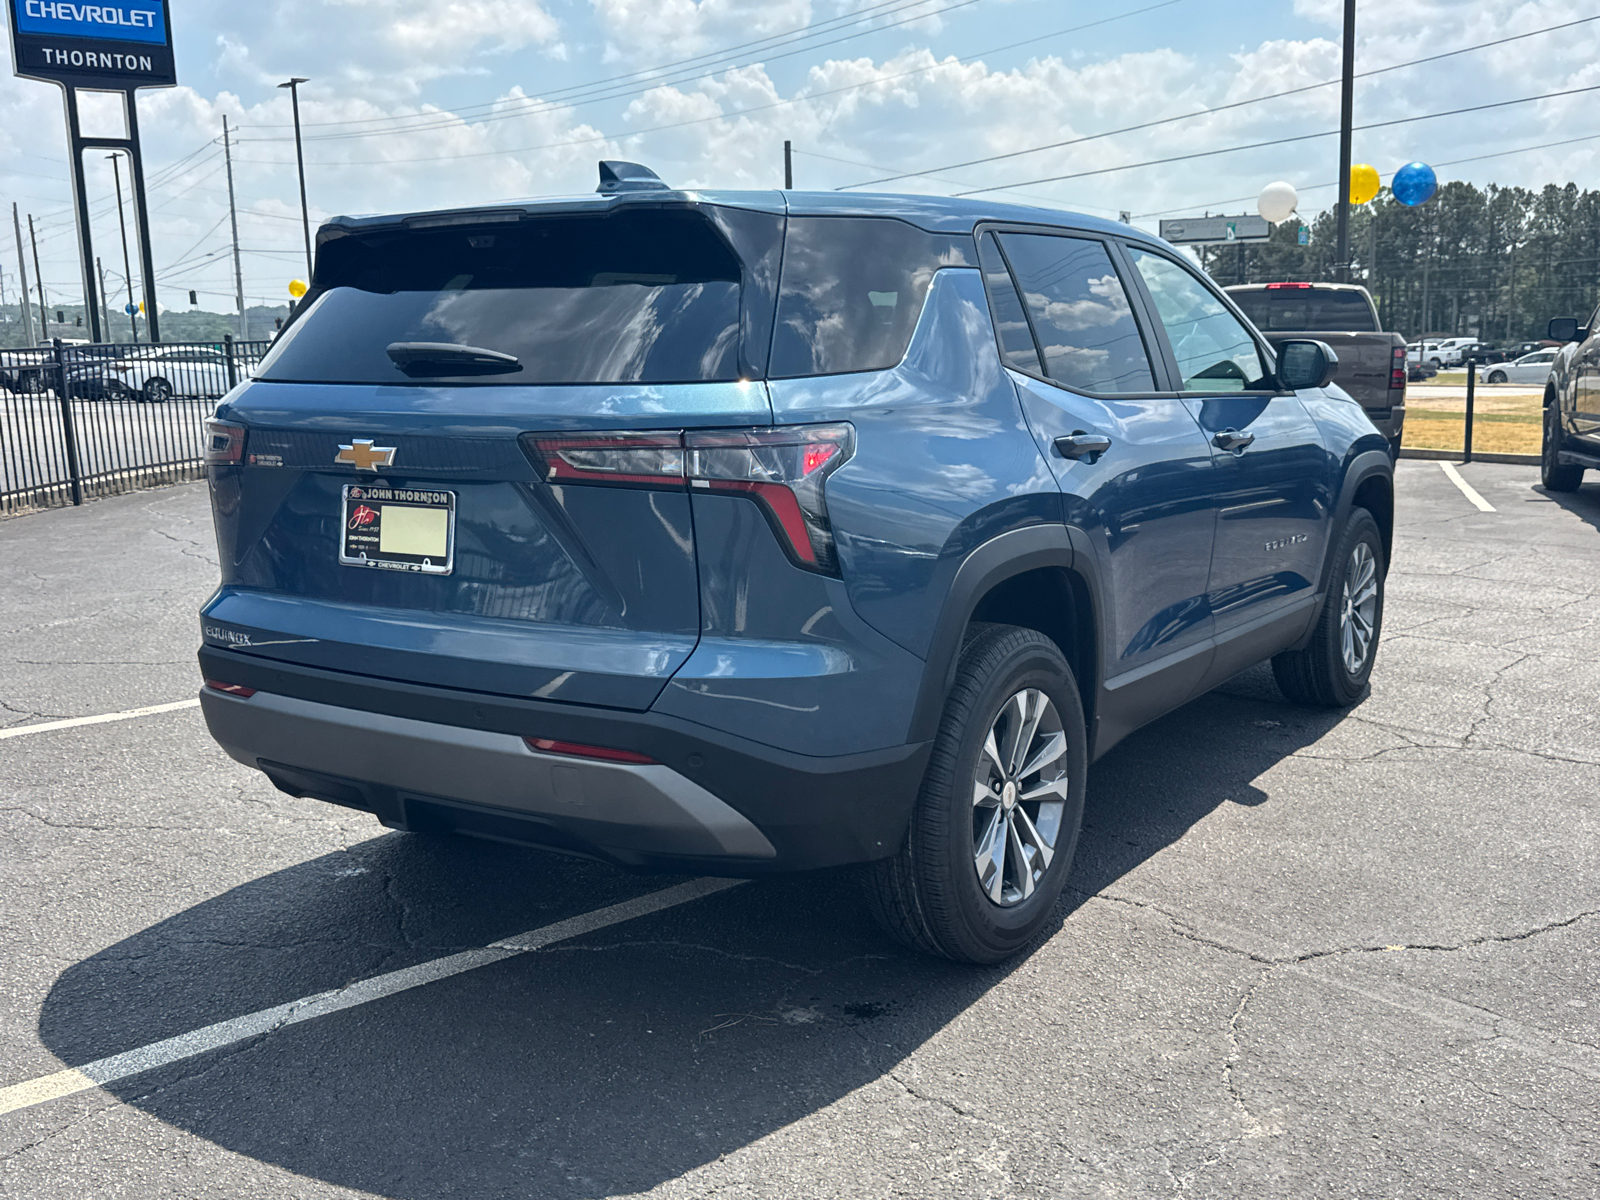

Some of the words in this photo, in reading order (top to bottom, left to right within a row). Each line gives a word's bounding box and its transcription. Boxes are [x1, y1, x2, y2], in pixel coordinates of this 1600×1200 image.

[25, 0, 156, 27] CHEVROLET
[42, 48, 152, 71] THORNTON
[367, 488, 392, 500] JOHN
[394, 490, 447, 503] THORNTON
[378, 562, 410, 570] CHEVROLET
[205, 625, 252, 646] EQUINOX
